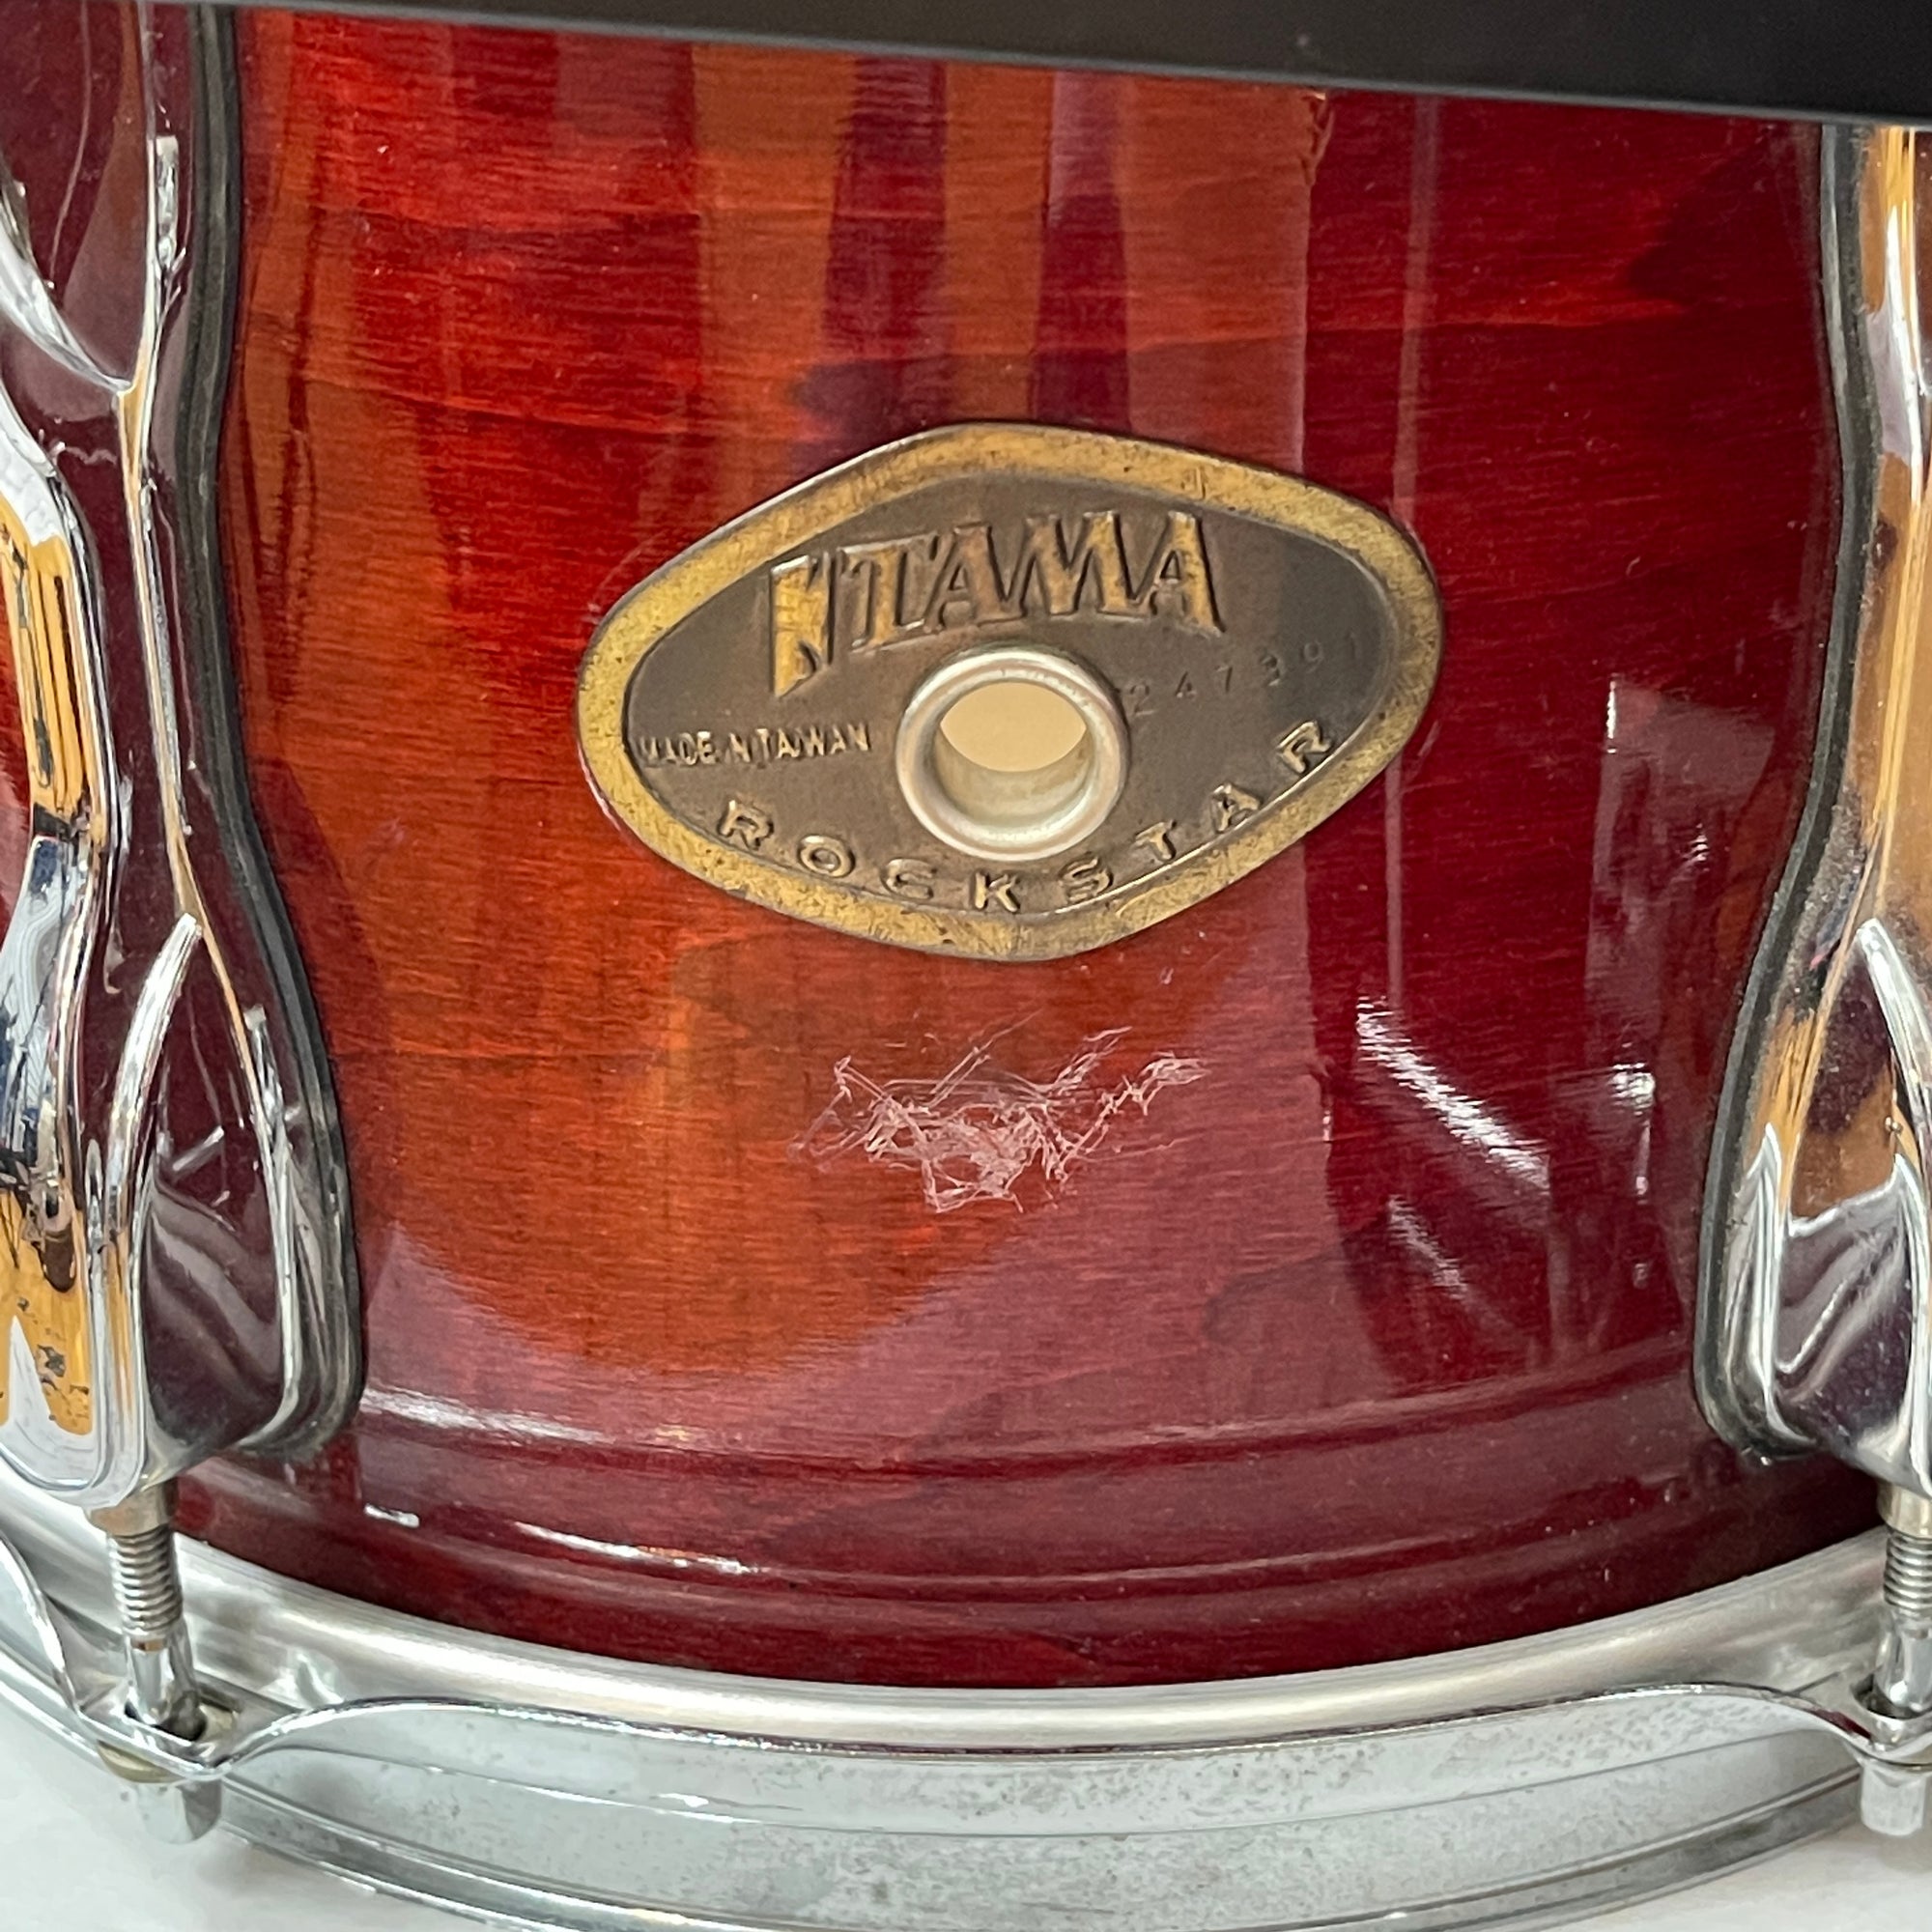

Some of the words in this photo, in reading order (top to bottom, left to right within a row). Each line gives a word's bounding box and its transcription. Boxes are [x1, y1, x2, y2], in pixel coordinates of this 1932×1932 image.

[837, 509, 1225, 646] TAMA
[755, 722, 871, 760] TAIWAN
[718, 719, 1334, 913] ROCKSTAR
